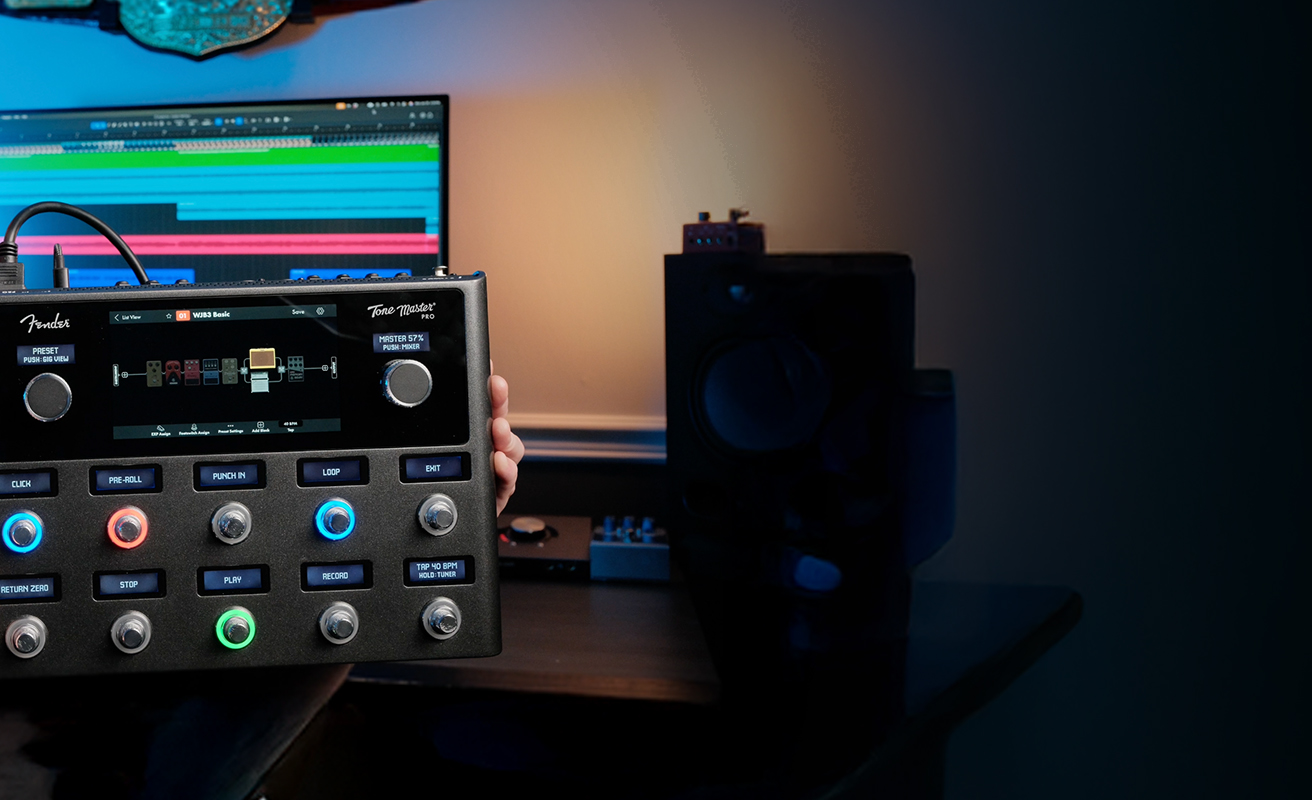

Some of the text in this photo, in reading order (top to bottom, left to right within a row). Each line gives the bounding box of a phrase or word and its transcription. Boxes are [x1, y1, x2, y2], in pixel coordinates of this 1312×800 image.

[367, 303, 434, 318] Tone Master
[19, 312, 70, 333] Fender
[379, 334, 424, 343] MASTER 57%
[32, 347, 59, 355] PRESET
[322, 468, 341, 476] LOOP
[425, 464, 441, 472] EXIT
[108, 476, 142, 484] PRE-ROLL
[212, 472, 246, 480] PUNCH IN
[11, 480, 31, 488] CLICK
[416, 563, 431, 571] TAP
[442, 562, 458, 570] BPM
[322, 572, 349, 580] RECORD
[0, 584, 49, 594] RETURN ZERO
[119, 581, 139, 589] STOP
